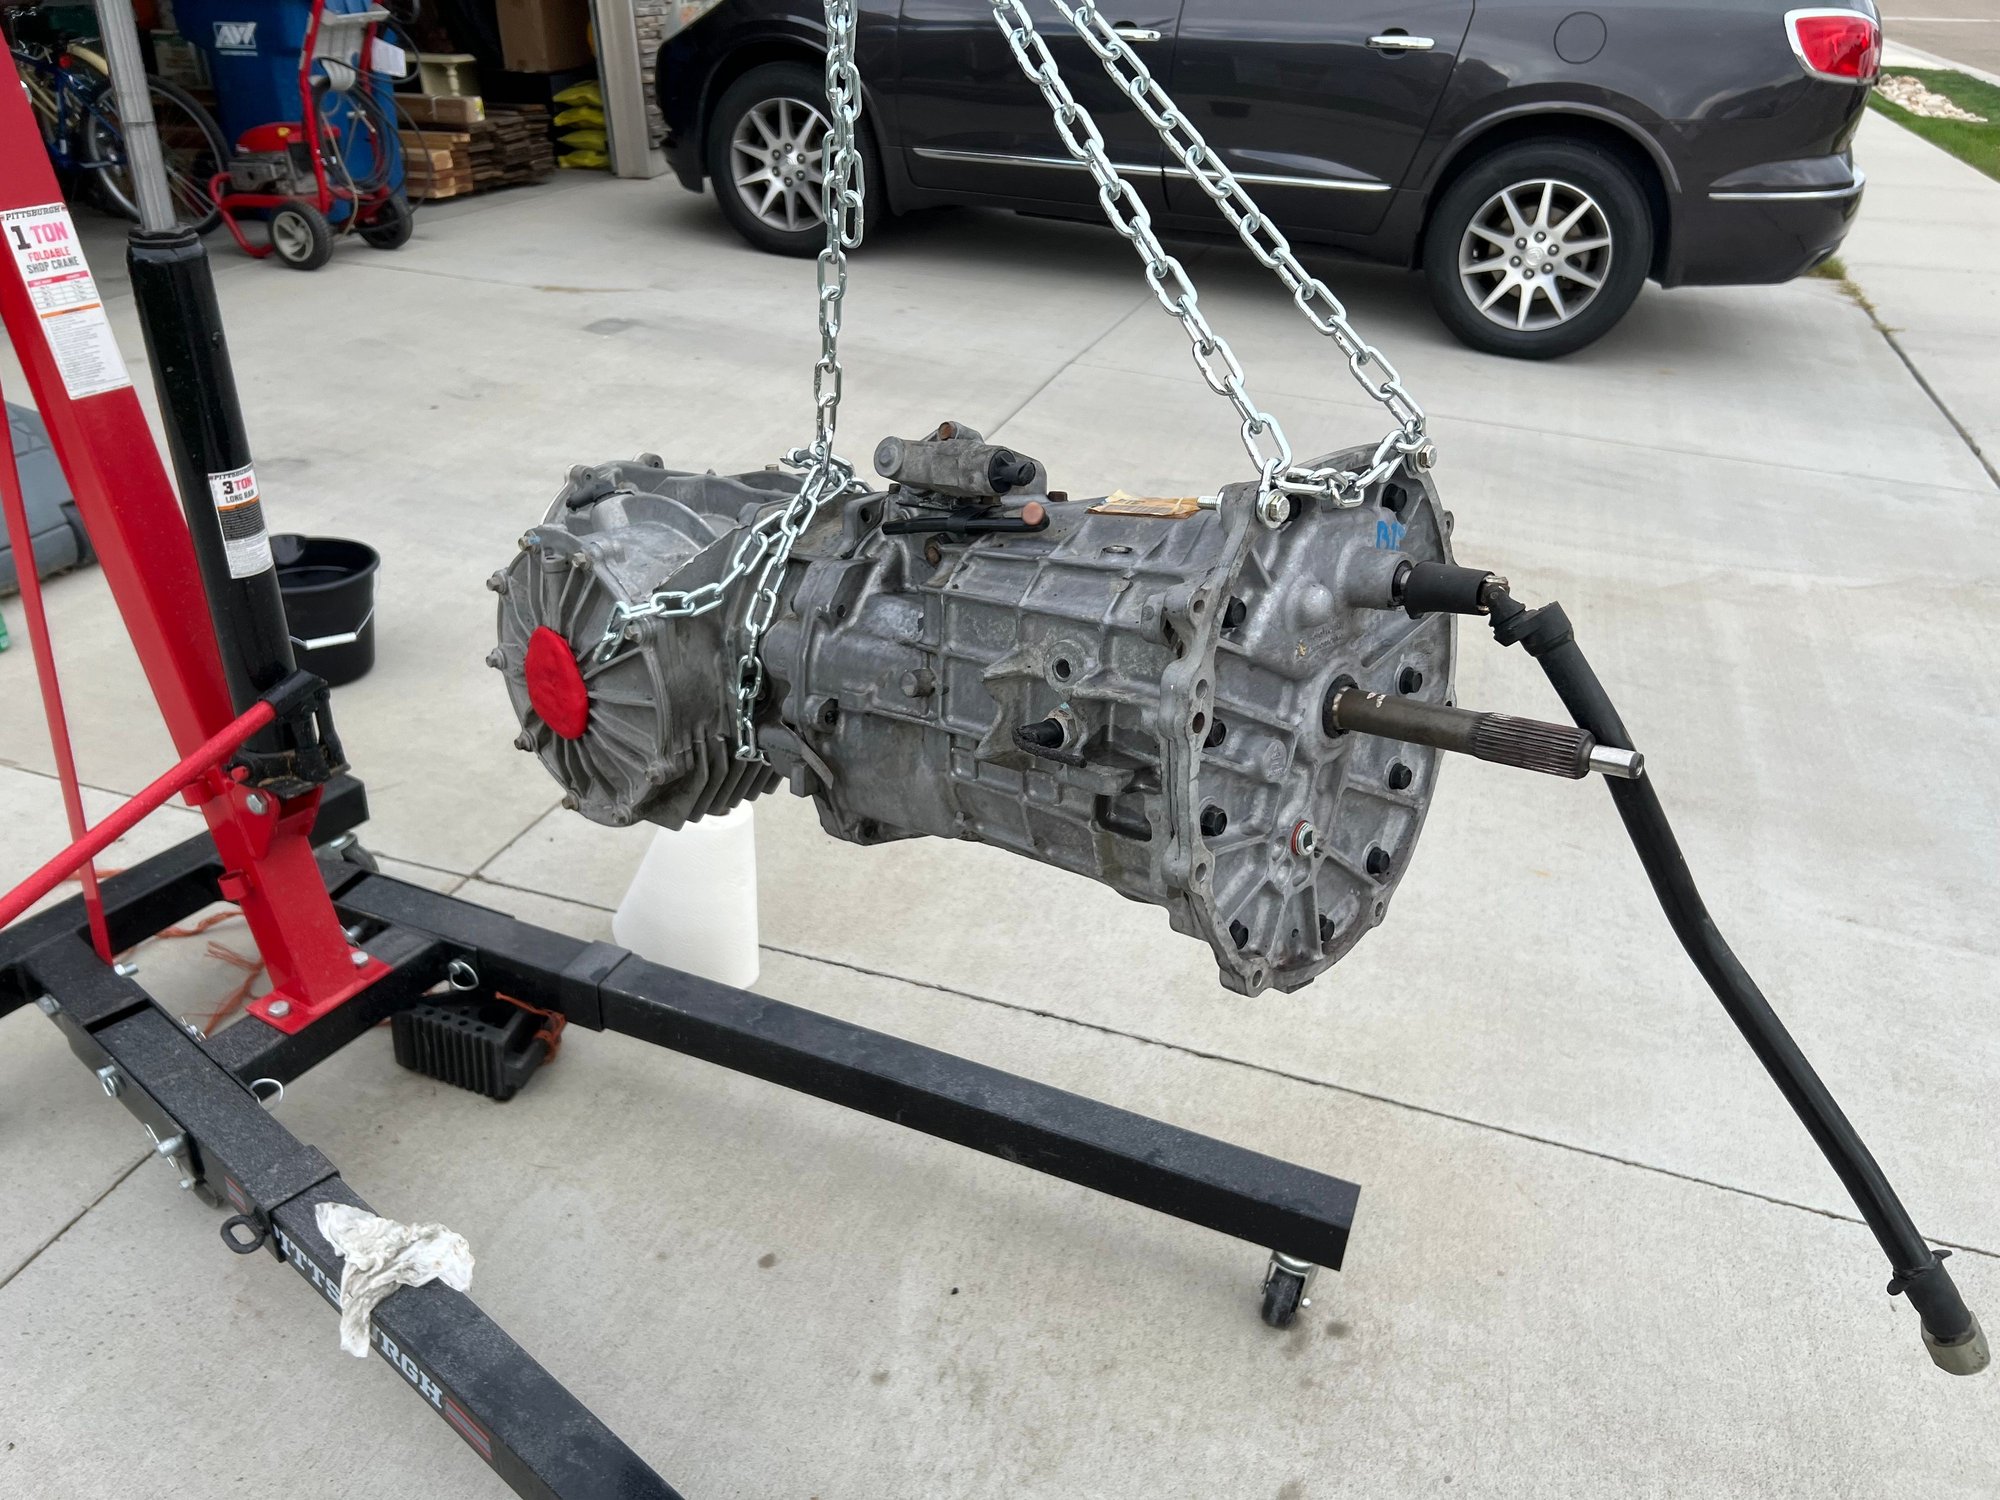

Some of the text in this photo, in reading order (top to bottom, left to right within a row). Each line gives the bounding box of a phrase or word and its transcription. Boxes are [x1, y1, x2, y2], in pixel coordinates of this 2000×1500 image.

[6, 205, 61, 220] PITTSBURGH
[11, 221, 69, 250] 1 TON
[28, 246, 71, 262] FOLDABLE
[27, 256, 80, 274] SHOP CRANE
[222, 476, 253, 495] 3 TON
[225, 493, 244, 503] LONG
